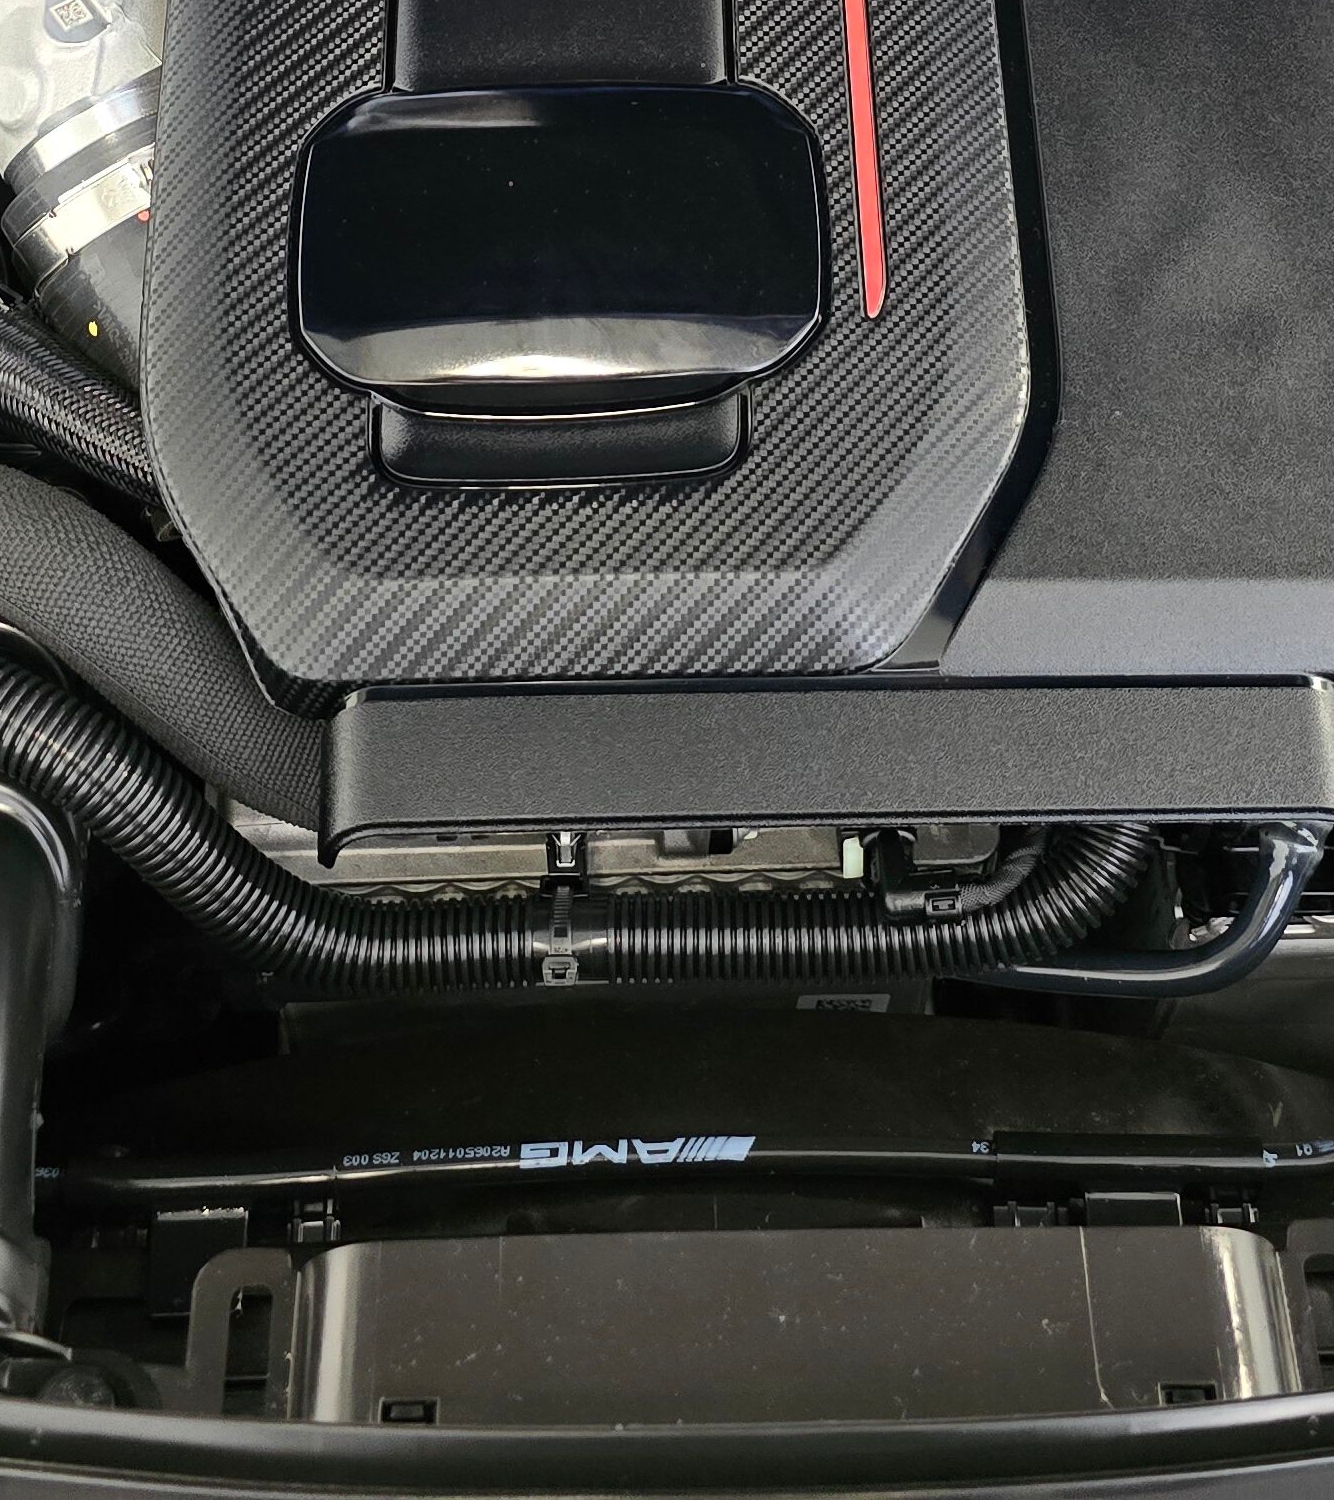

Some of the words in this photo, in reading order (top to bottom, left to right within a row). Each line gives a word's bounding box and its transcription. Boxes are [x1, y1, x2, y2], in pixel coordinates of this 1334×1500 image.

[343, 1153, 370, 1167] 003
[412, 1144, 511, 1162] A2065011204
[519, 1136, 697, 1169] AMG
